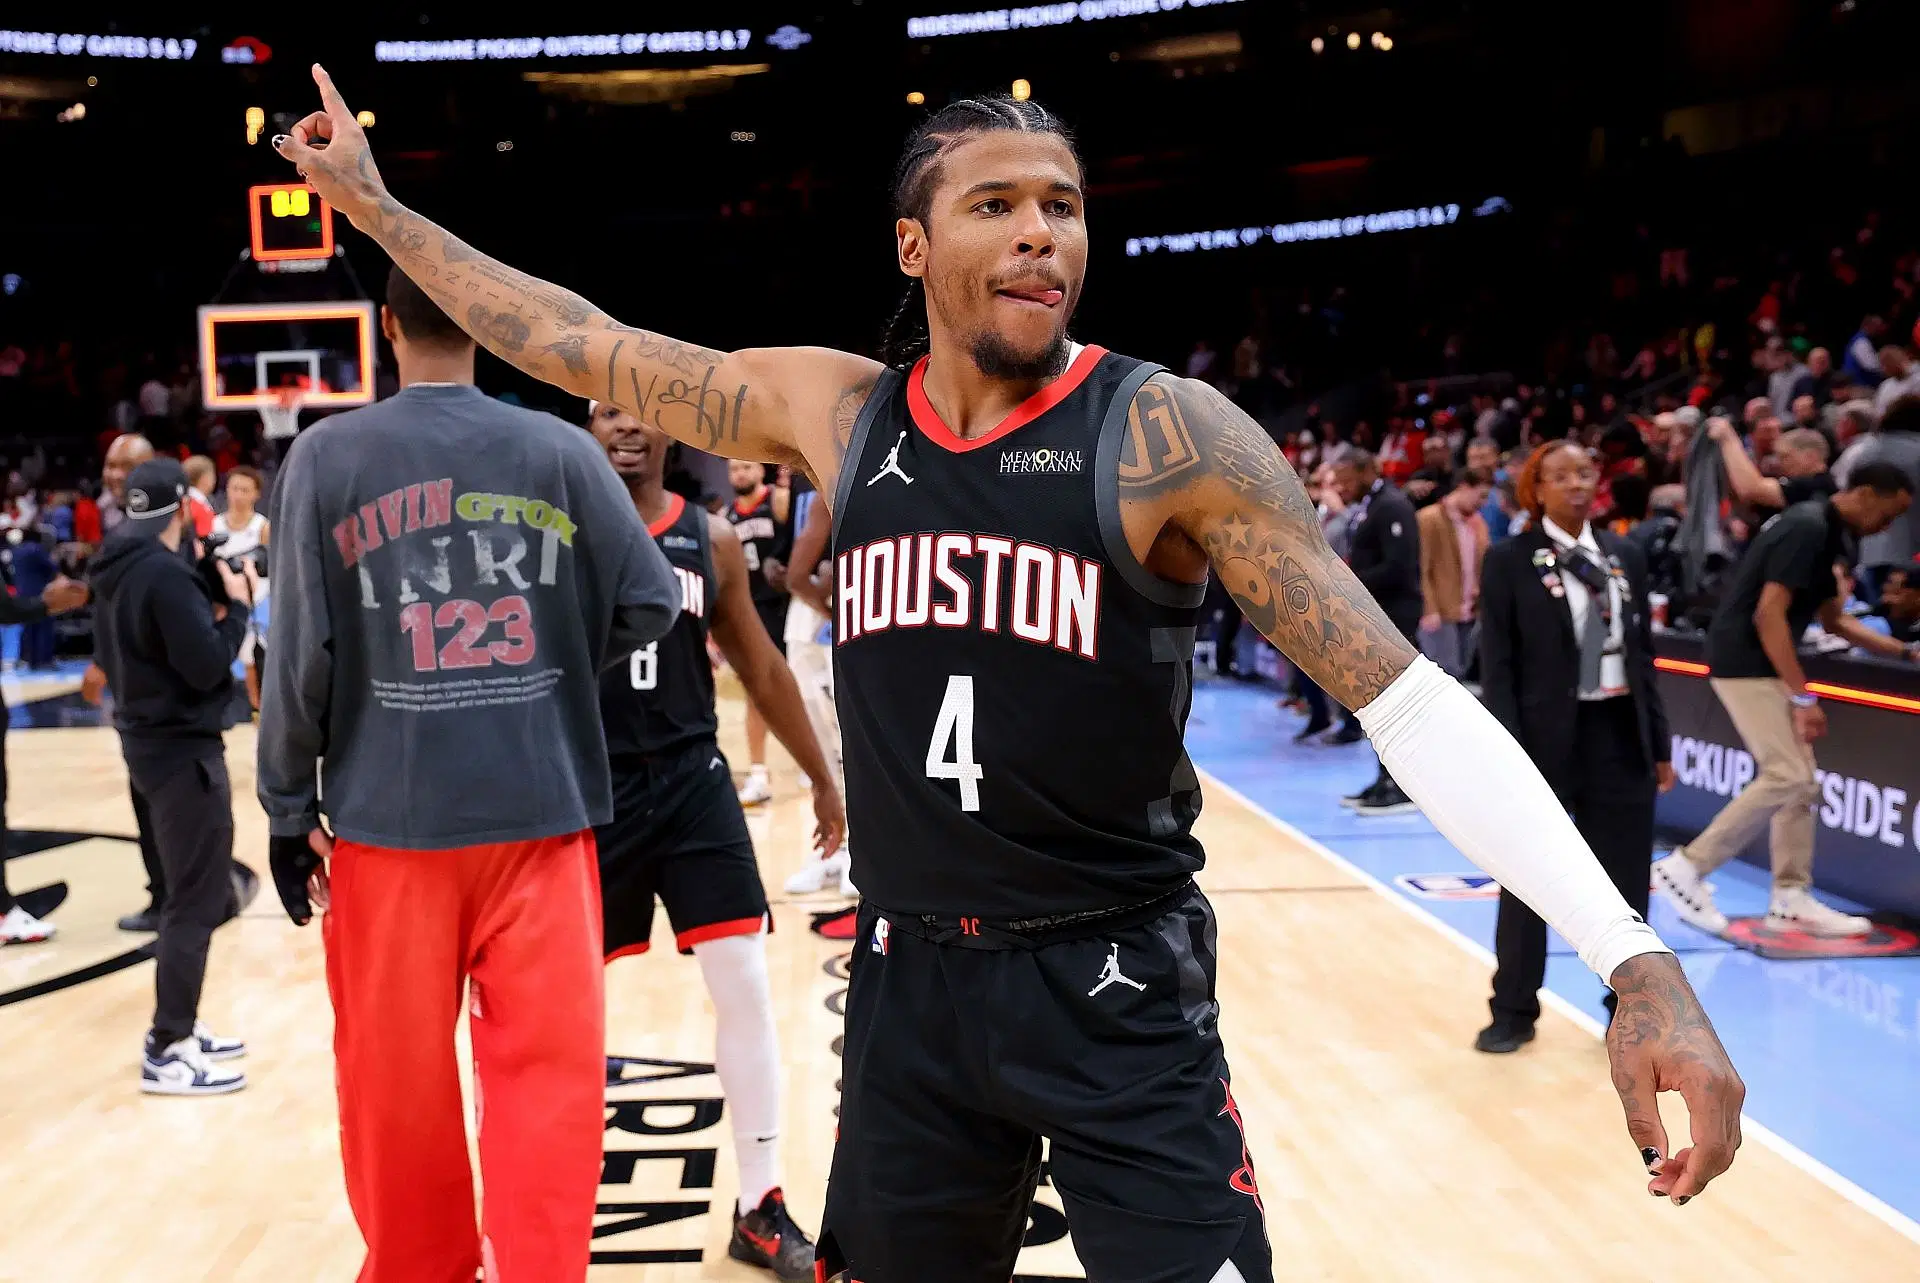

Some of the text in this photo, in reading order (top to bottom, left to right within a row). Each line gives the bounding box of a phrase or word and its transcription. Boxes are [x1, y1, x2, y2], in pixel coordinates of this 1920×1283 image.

[999, 460, 1082, 473] HERMANN
[1000, 448, 1084, 465] MEMORIAL
[400, 594, 537, 673] 123
[836, 532, 1103, 662] HOUSTON
[925, 674, 984, 812] 4
